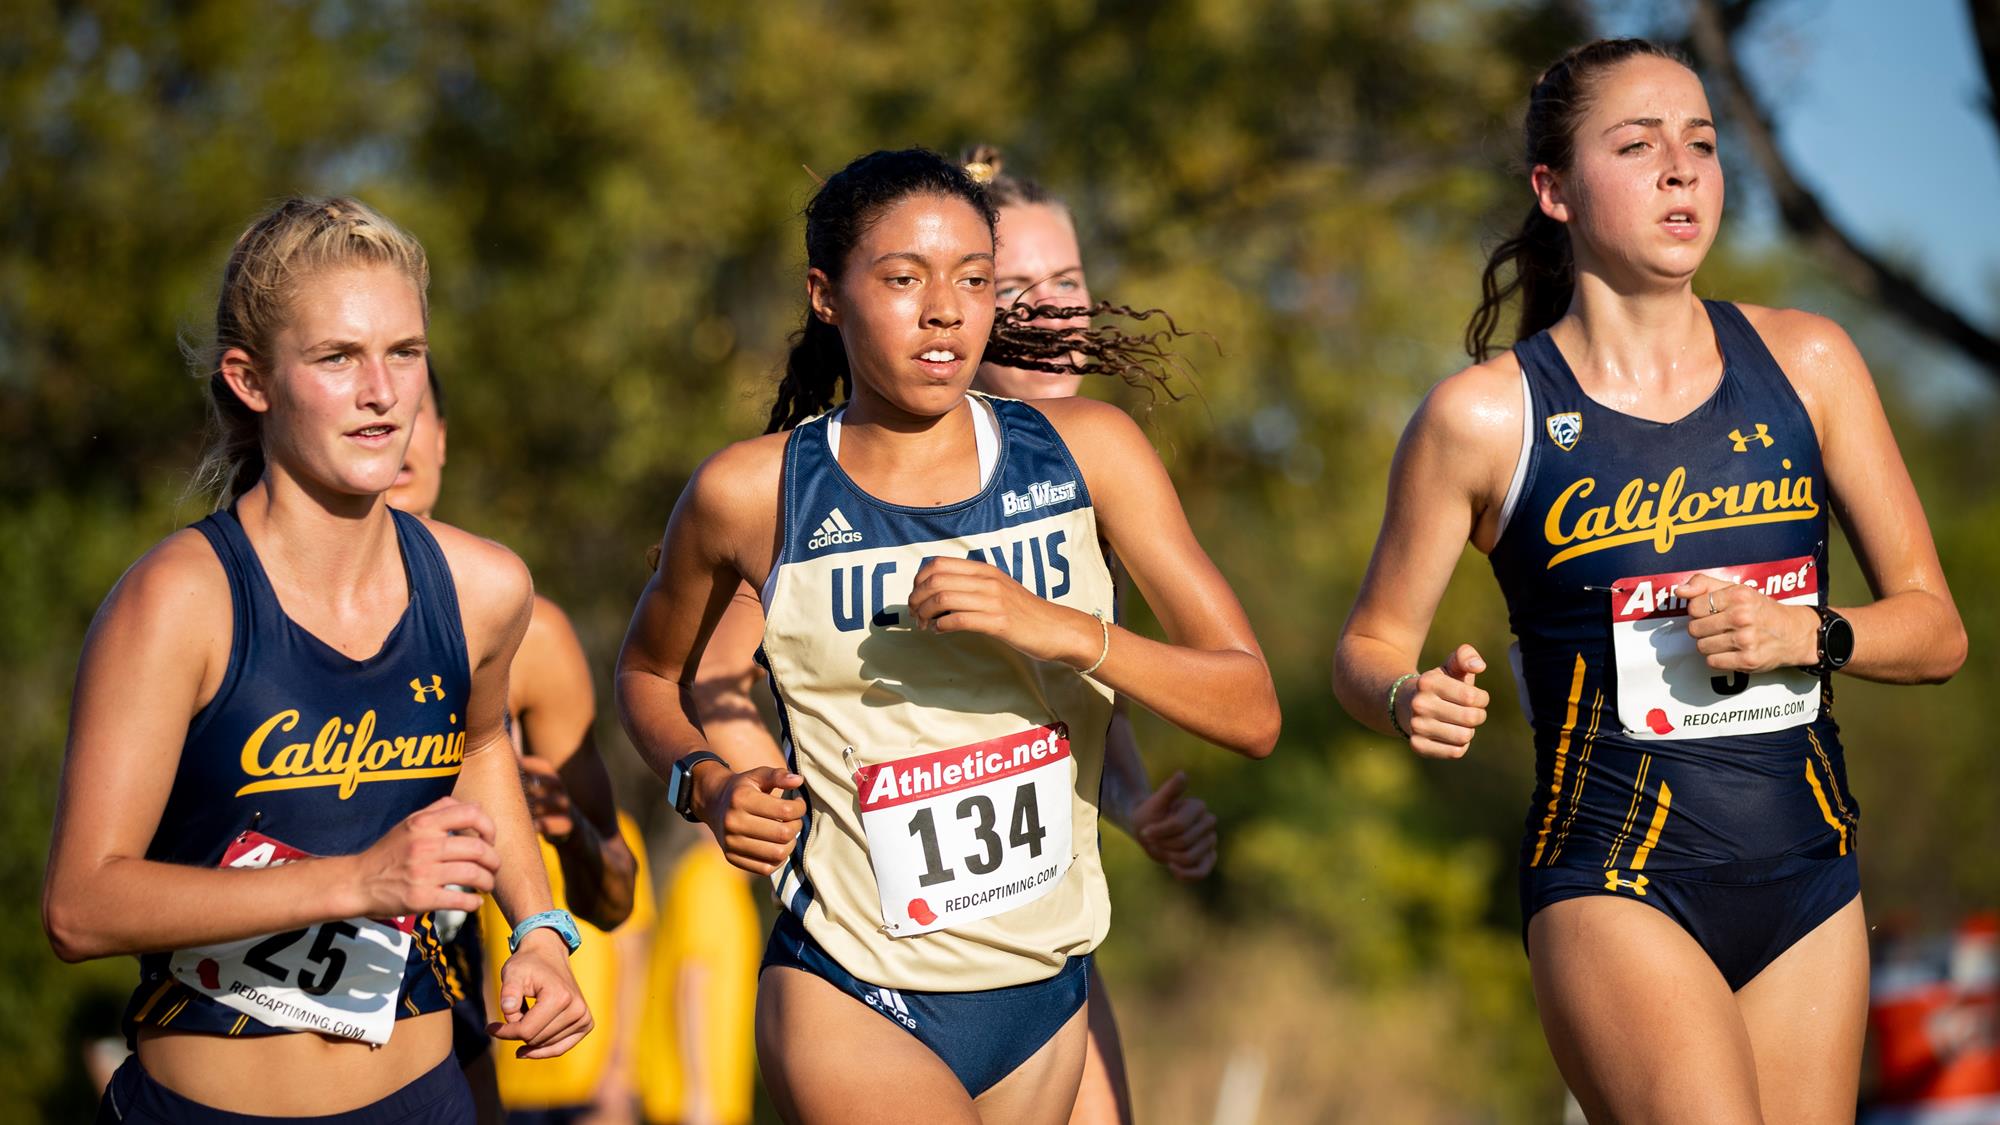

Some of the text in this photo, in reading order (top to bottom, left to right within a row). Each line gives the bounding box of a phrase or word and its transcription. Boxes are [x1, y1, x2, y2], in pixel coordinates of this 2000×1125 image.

[1558, 428, 1576, 444] 12
[808, 530, 862, 550] adidas
[1544, 459, 1819, 569] California
[831, 530, 1071, 633] UC VIS
[1683, 700, 1805, 727] REDCAPTIMING.COM
[866, 730, 1059, 805] Athletic.net
[907, 781, 1047, 888] 134
[945, 864, 1058, 913] REDCAPTIMING.COM
[229, 980, 366, 1040] REDCAPTIMING.COM
